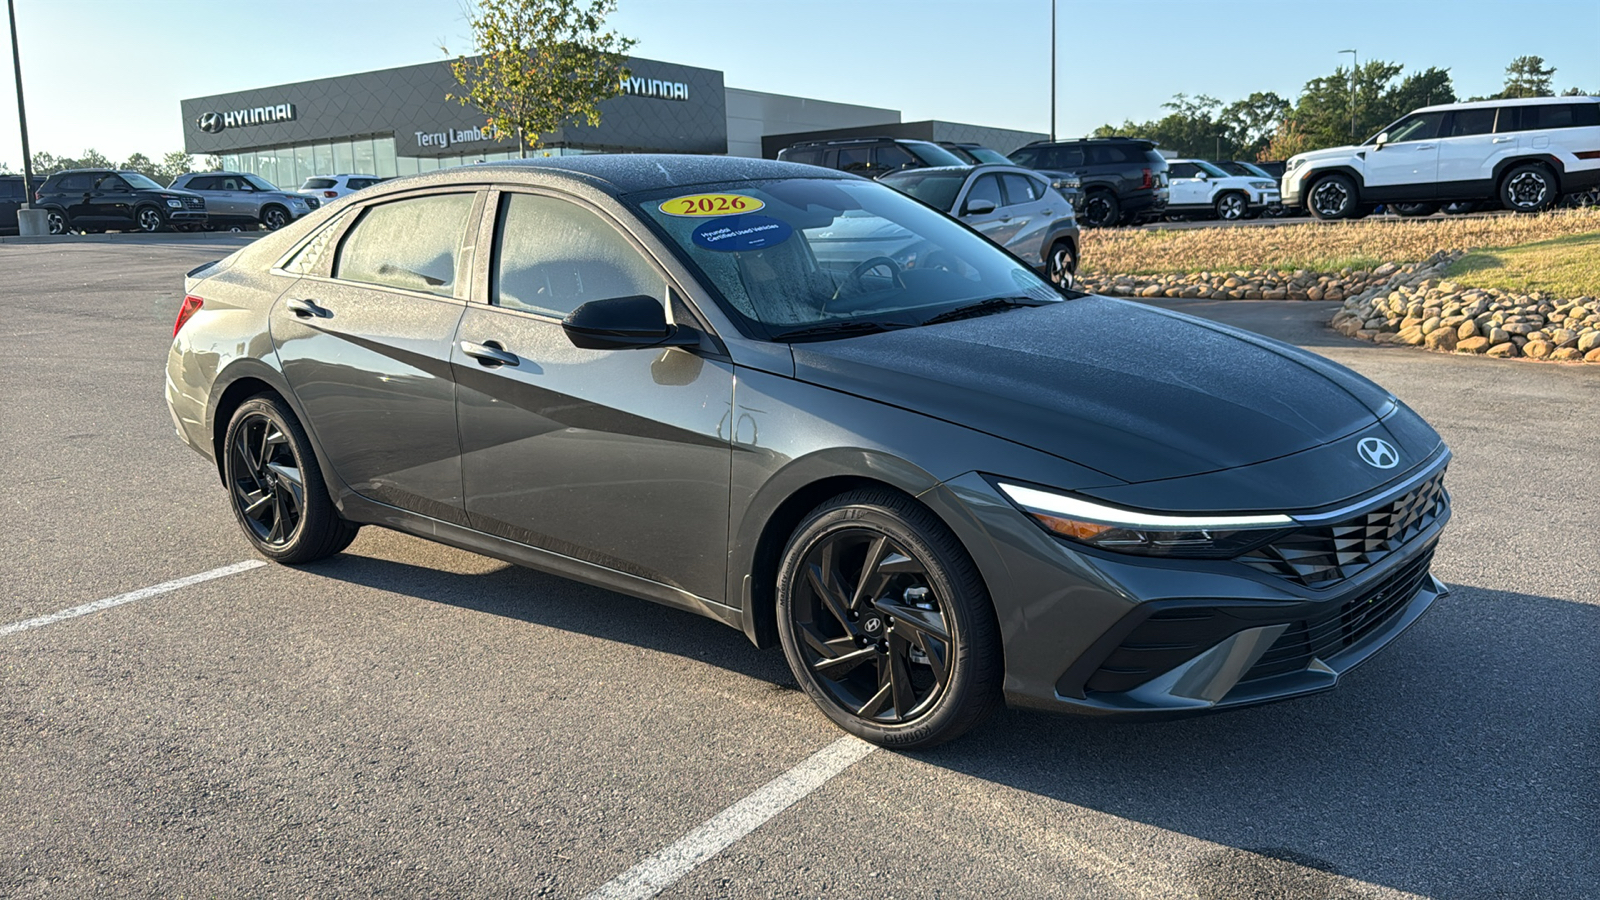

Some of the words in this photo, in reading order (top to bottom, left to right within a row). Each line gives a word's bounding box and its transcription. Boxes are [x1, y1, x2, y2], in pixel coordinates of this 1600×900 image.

[619, 76, 689, 100] HYUNDAI
[223, 103, 292, 127] HYUNDAI
[415, 131, 448, 148] Terry
[681, 197, 746, 214] 2026
[701, 227, 731, 238] Hyundai
[707, 232, 736, 242] Certified
[735, 228, 754, 236] Used
[752, 224, 779, 232] Vehicles
[885, 724, 932, 744] KUMHO
